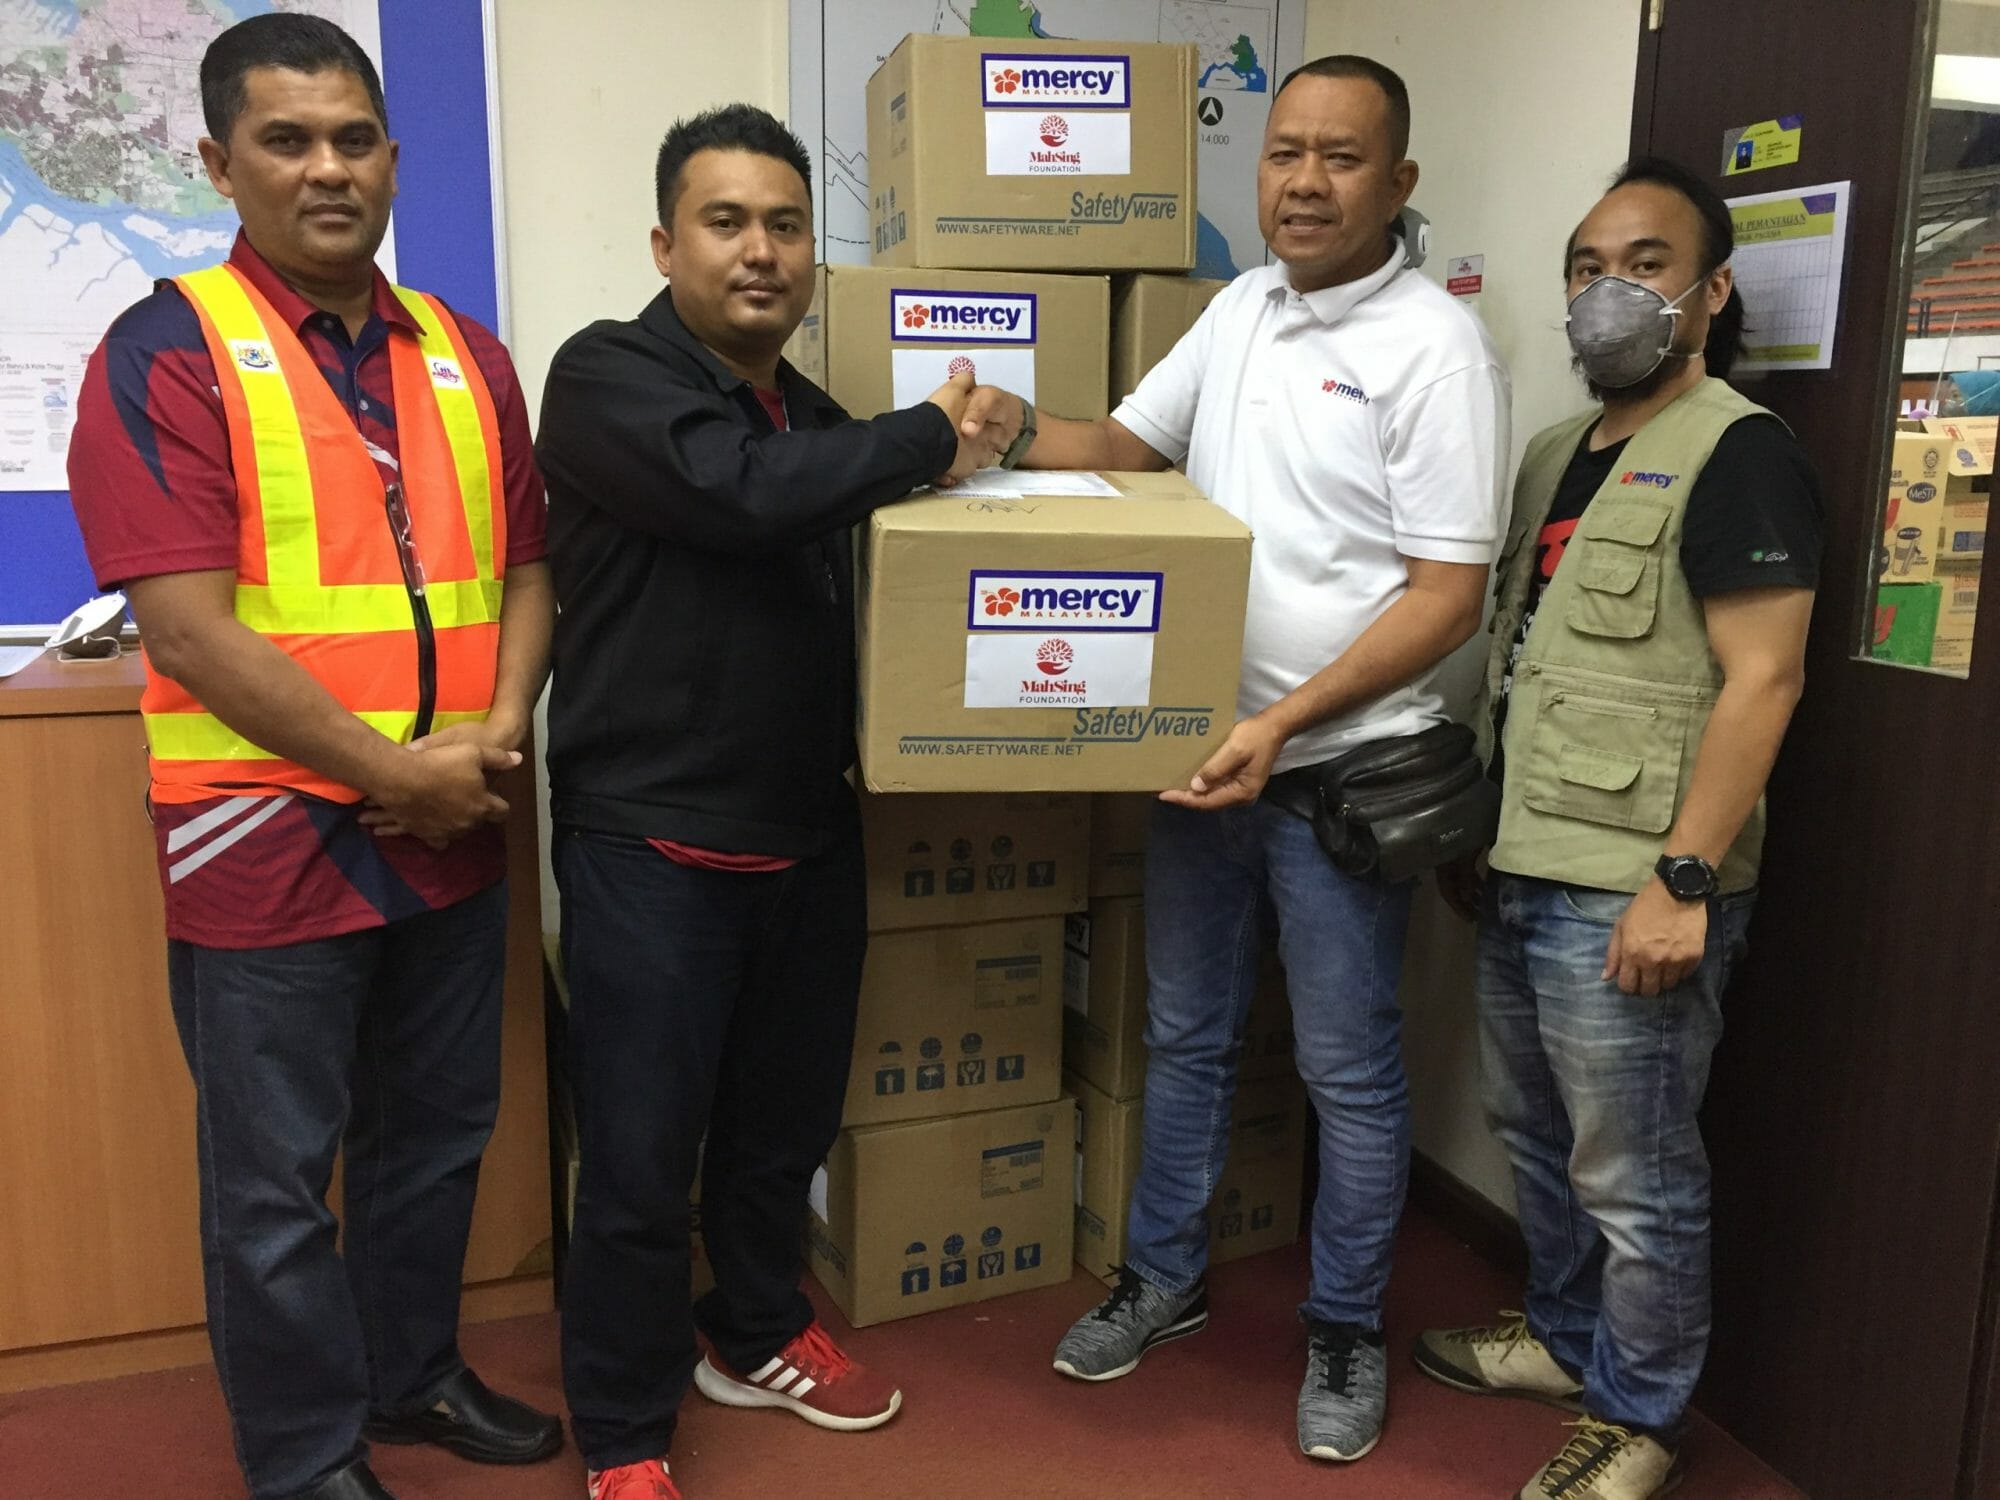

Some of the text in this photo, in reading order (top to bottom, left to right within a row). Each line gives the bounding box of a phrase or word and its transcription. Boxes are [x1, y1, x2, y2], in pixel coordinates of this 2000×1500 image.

[1022, 69, 1114, 95] mercy
[1029, 151, 1081, 165] MahSing
[1029, 165, 1081, 173] FOUNDATION
[1070, 190, 1178, 223] Safetyware
[935, 223, 1081, 236] WWW.SAFETYWARE.NET
[930, 304, 1022, 331] mercy
[930, 324, 1003, 332] MALAYSIA
[1633, 471, 1674, 489] mercy
[1021, 587, 1142, 618] mercy
[1021, 680, 1086, 695] MahSing
[1019, 696, 1086, 704] FOUNDATION
[1073, 707, 1212, 741] Safetyware
[898, 742, 1085, 757] WWW.SAFETYWARE.NET
